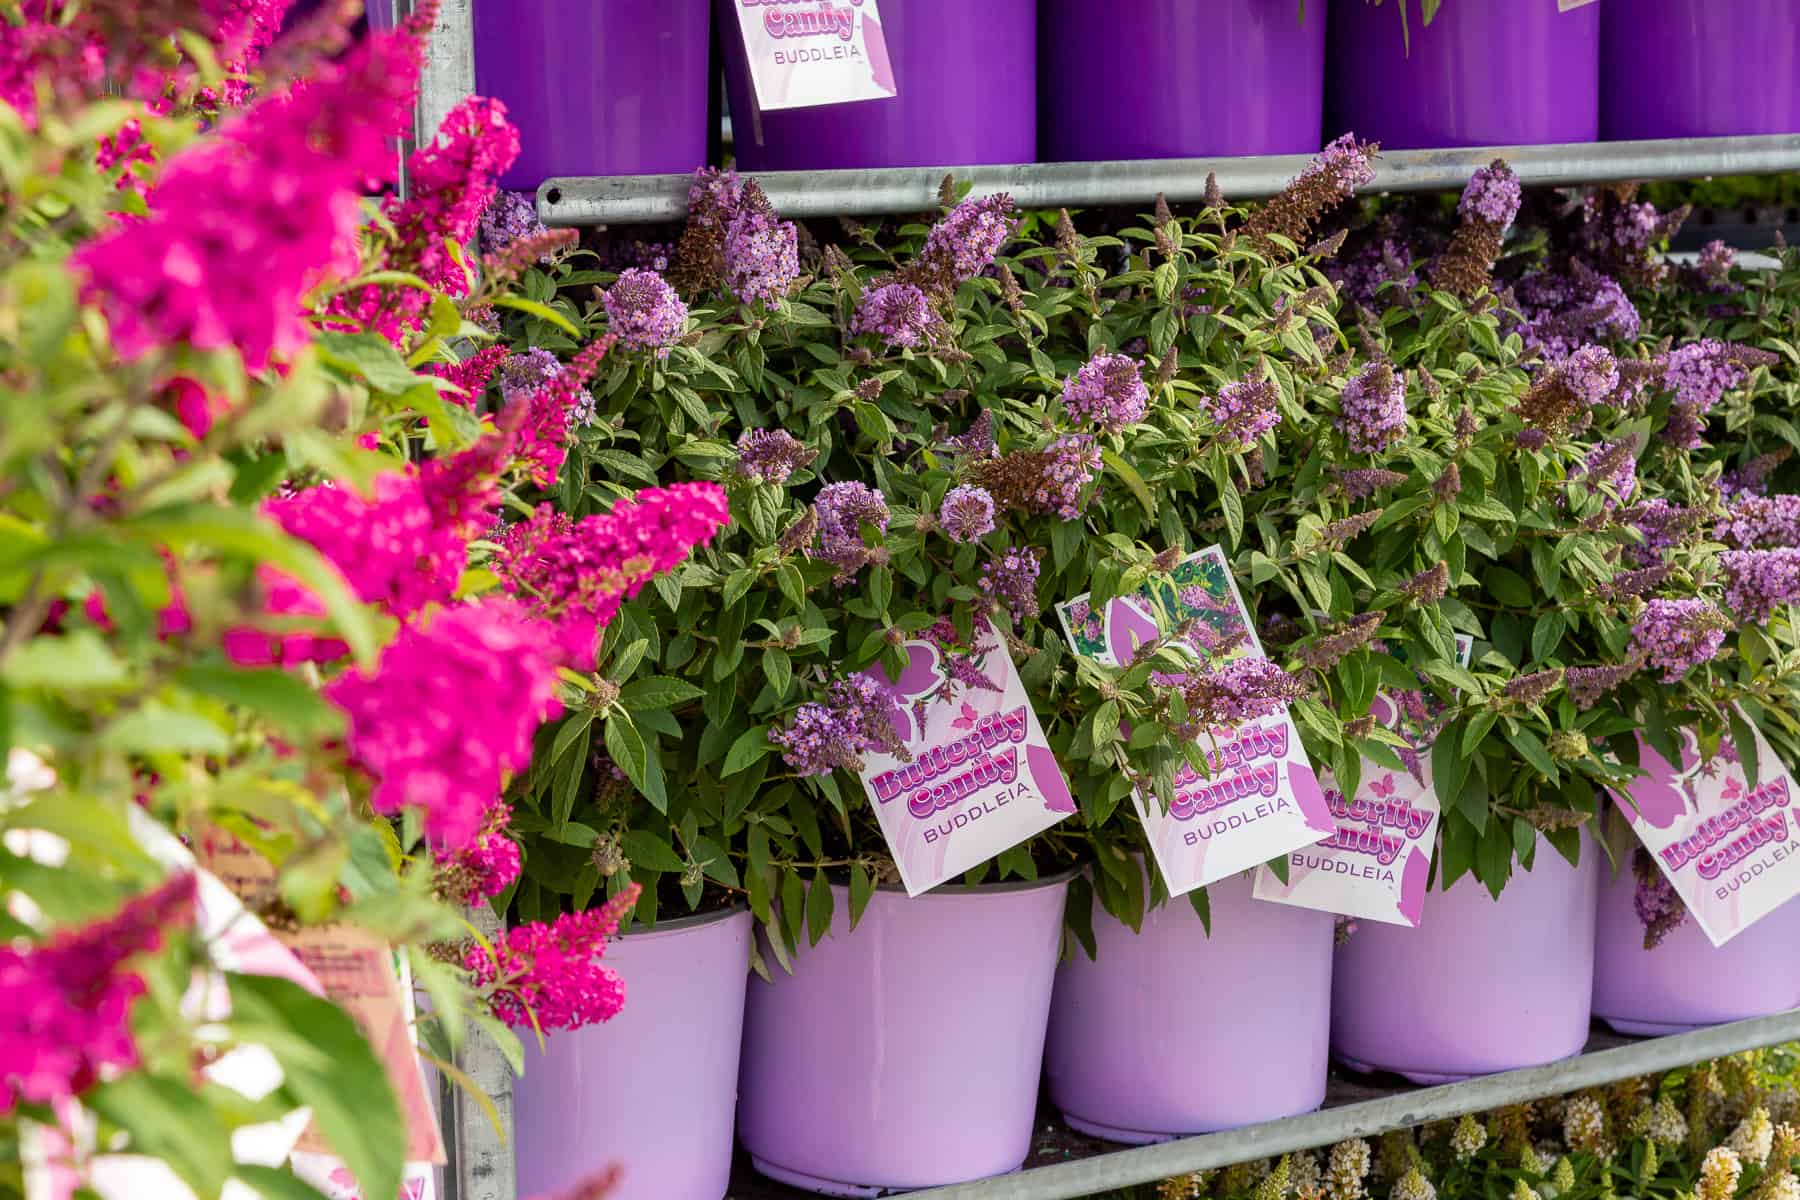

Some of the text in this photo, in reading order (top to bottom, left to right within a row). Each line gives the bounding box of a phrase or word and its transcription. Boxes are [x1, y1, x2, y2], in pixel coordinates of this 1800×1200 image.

[763, 3, 854, 41] Candy
[775, 45, 861, 65] BUDDLEIA
[869, 705, 1027, 804] Butterfly
[907, 746, 1018, 820] Candy
[923, 782, 1030, 844] BUDDLEIA
[1169, 761, 1278, 821] Candy
[1183, 797, 1290, 846] BUDDLEIA
[1658, 775, 1791, 872] Butterfly
[1696, 810, 1789, 880] Candy
[1291, 854, 1395, 883] BUDDLEIA
[1715, 840, 1800, 900] BUDDLEIA
